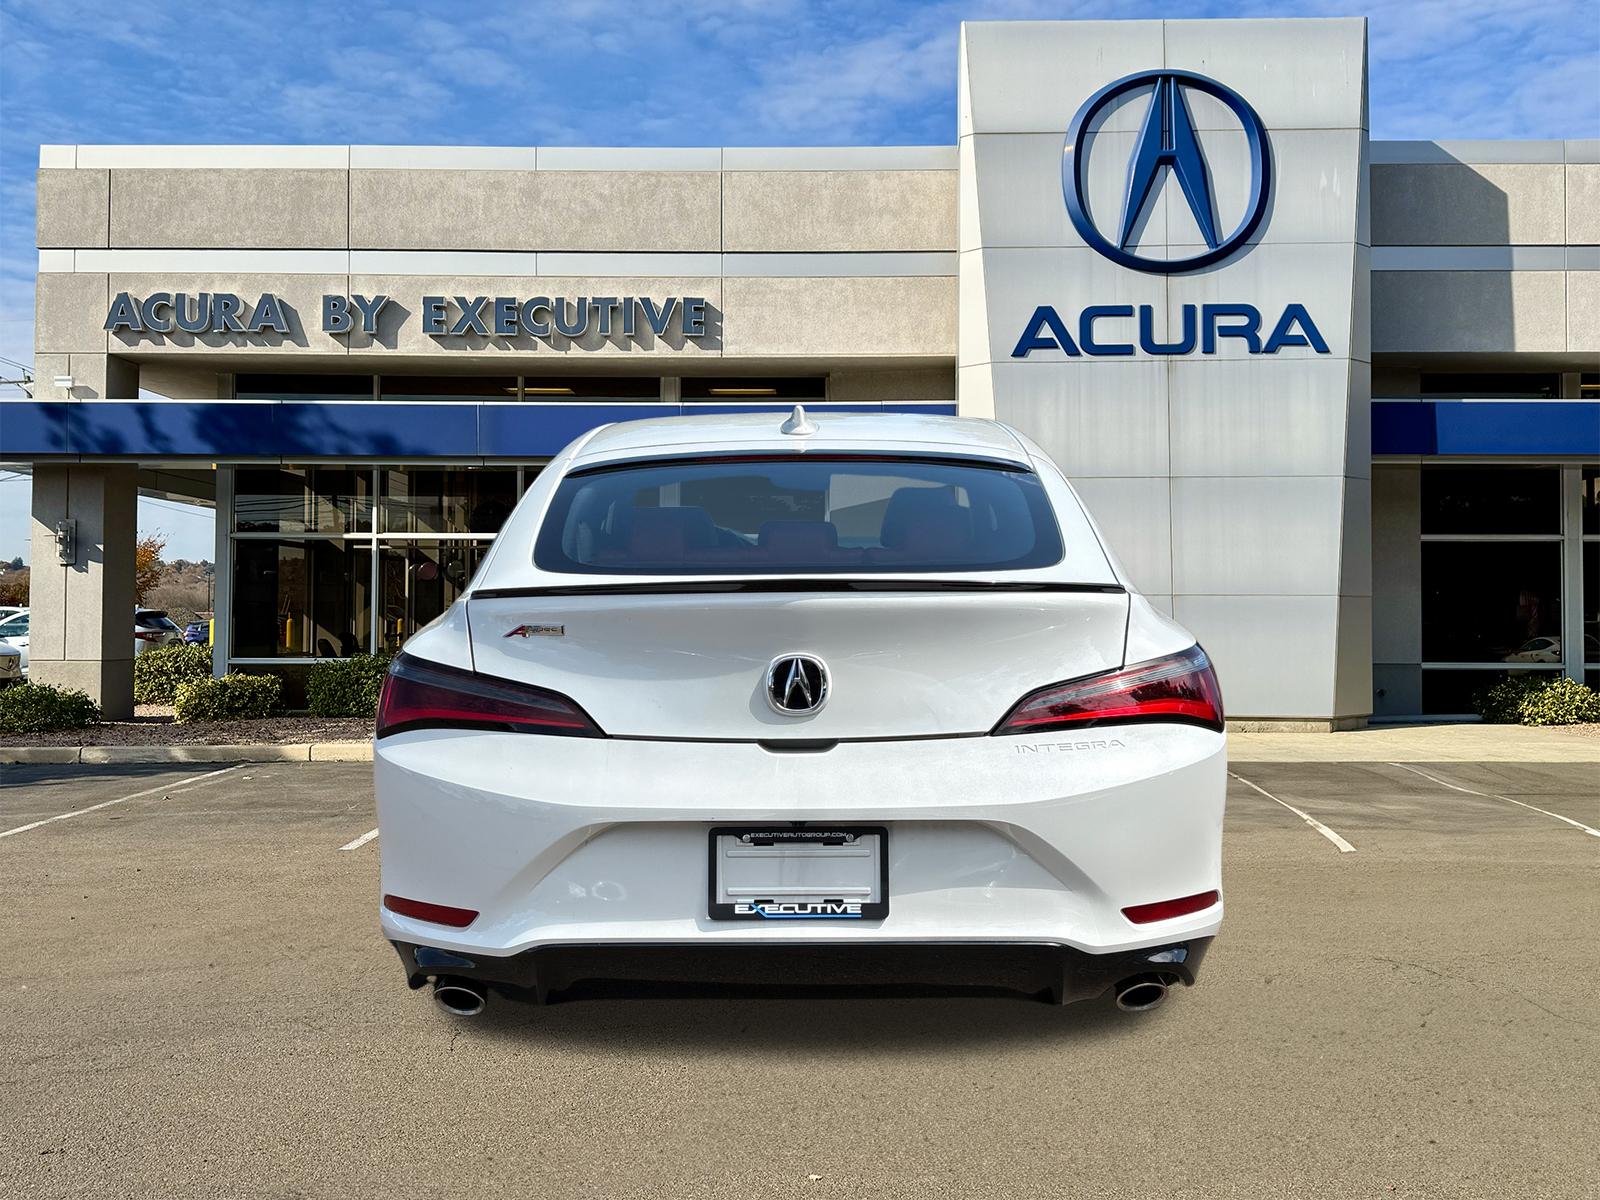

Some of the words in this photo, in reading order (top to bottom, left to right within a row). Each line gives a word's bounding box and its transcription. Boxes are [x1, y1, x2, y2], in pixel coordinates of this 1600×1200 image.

[104, 291, 288, 334] ACURA
[322, 294, 390, 335] BY
[421, 296, 706, 337] EXECUTIVE
[1011, 304, 1331, 357] ACURA
[1015, 739, 1126, 754] INTEGRA
[734, 903, 862, 915] EXECUTIVE
